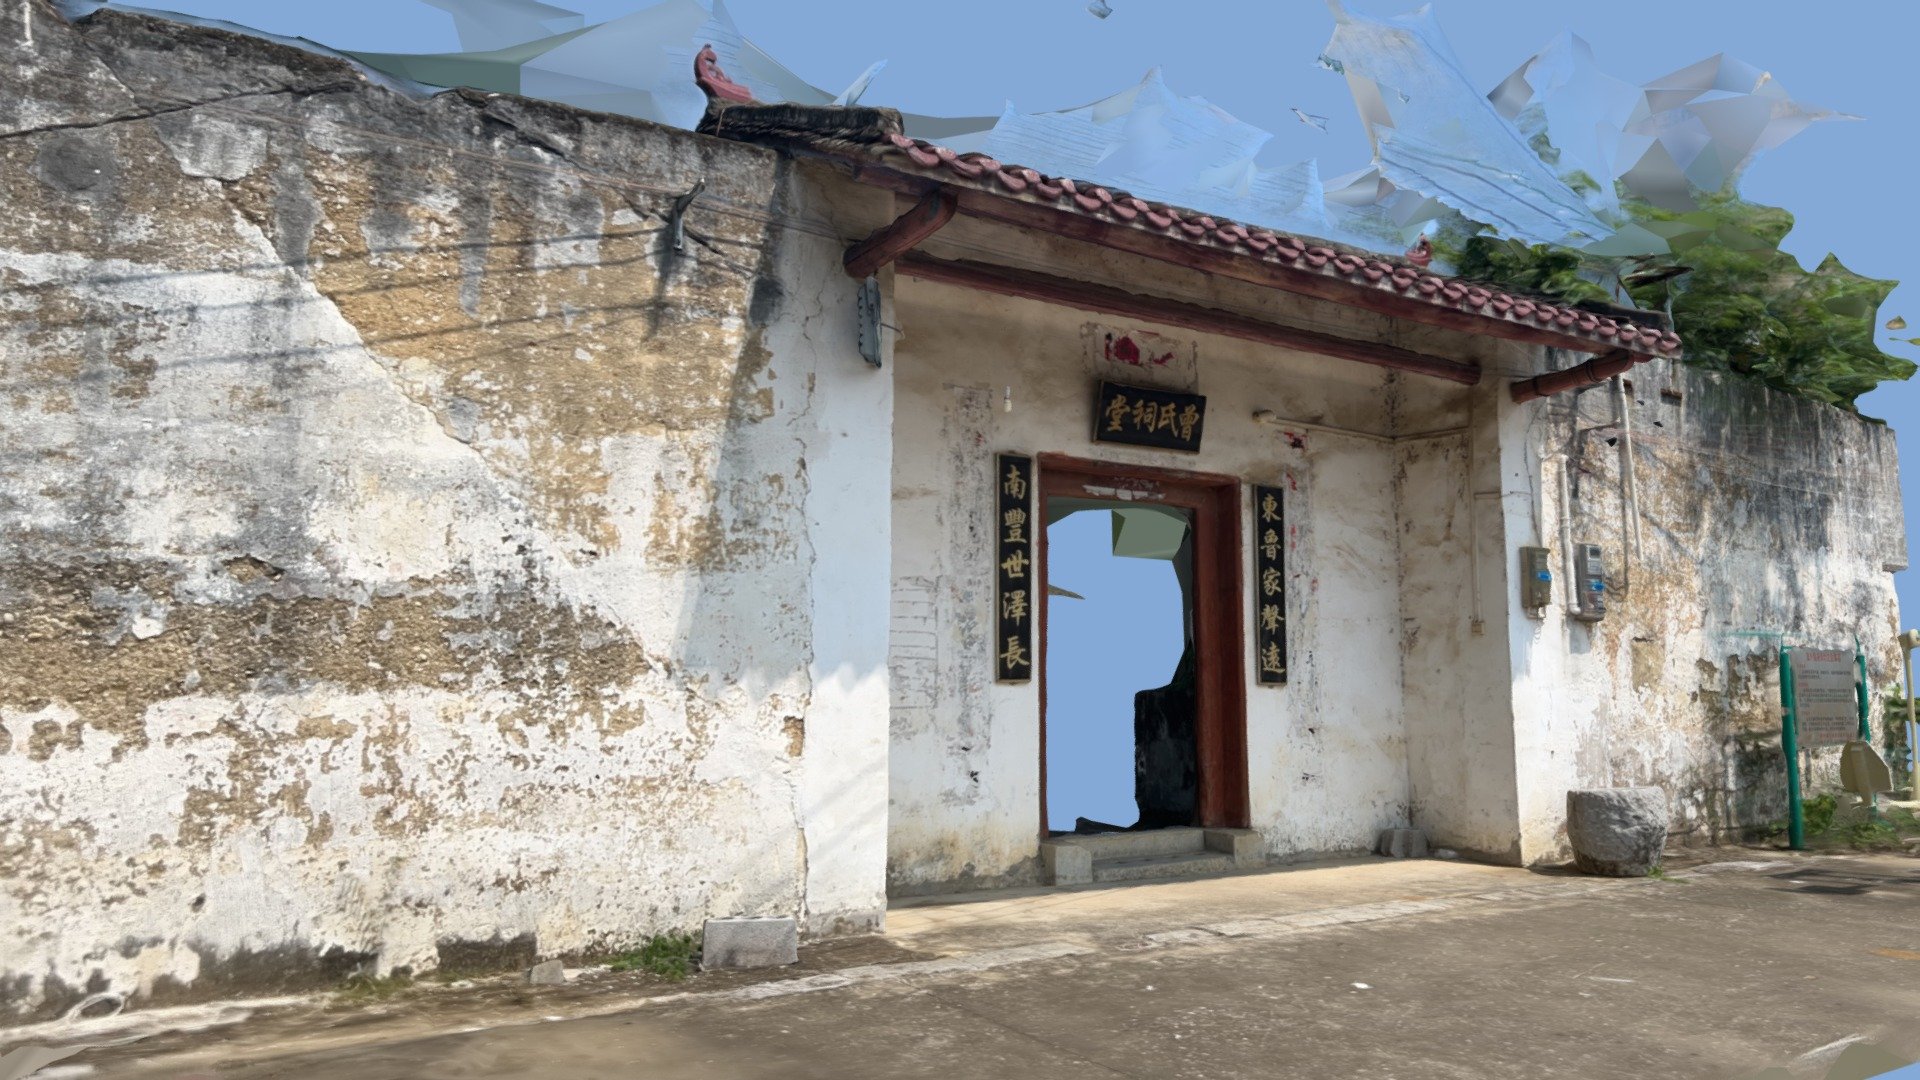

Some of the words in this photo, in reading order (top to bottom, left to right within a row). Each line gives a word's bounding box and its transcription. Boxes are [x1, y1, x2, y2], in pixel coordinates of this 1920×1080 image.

[1105, 394, 1199, 442] 曾氏祠堂
[1001, 464, 1030, 669] 南豐世澤長
[1260, 493, 1286, 674] 東魯家聲遠
